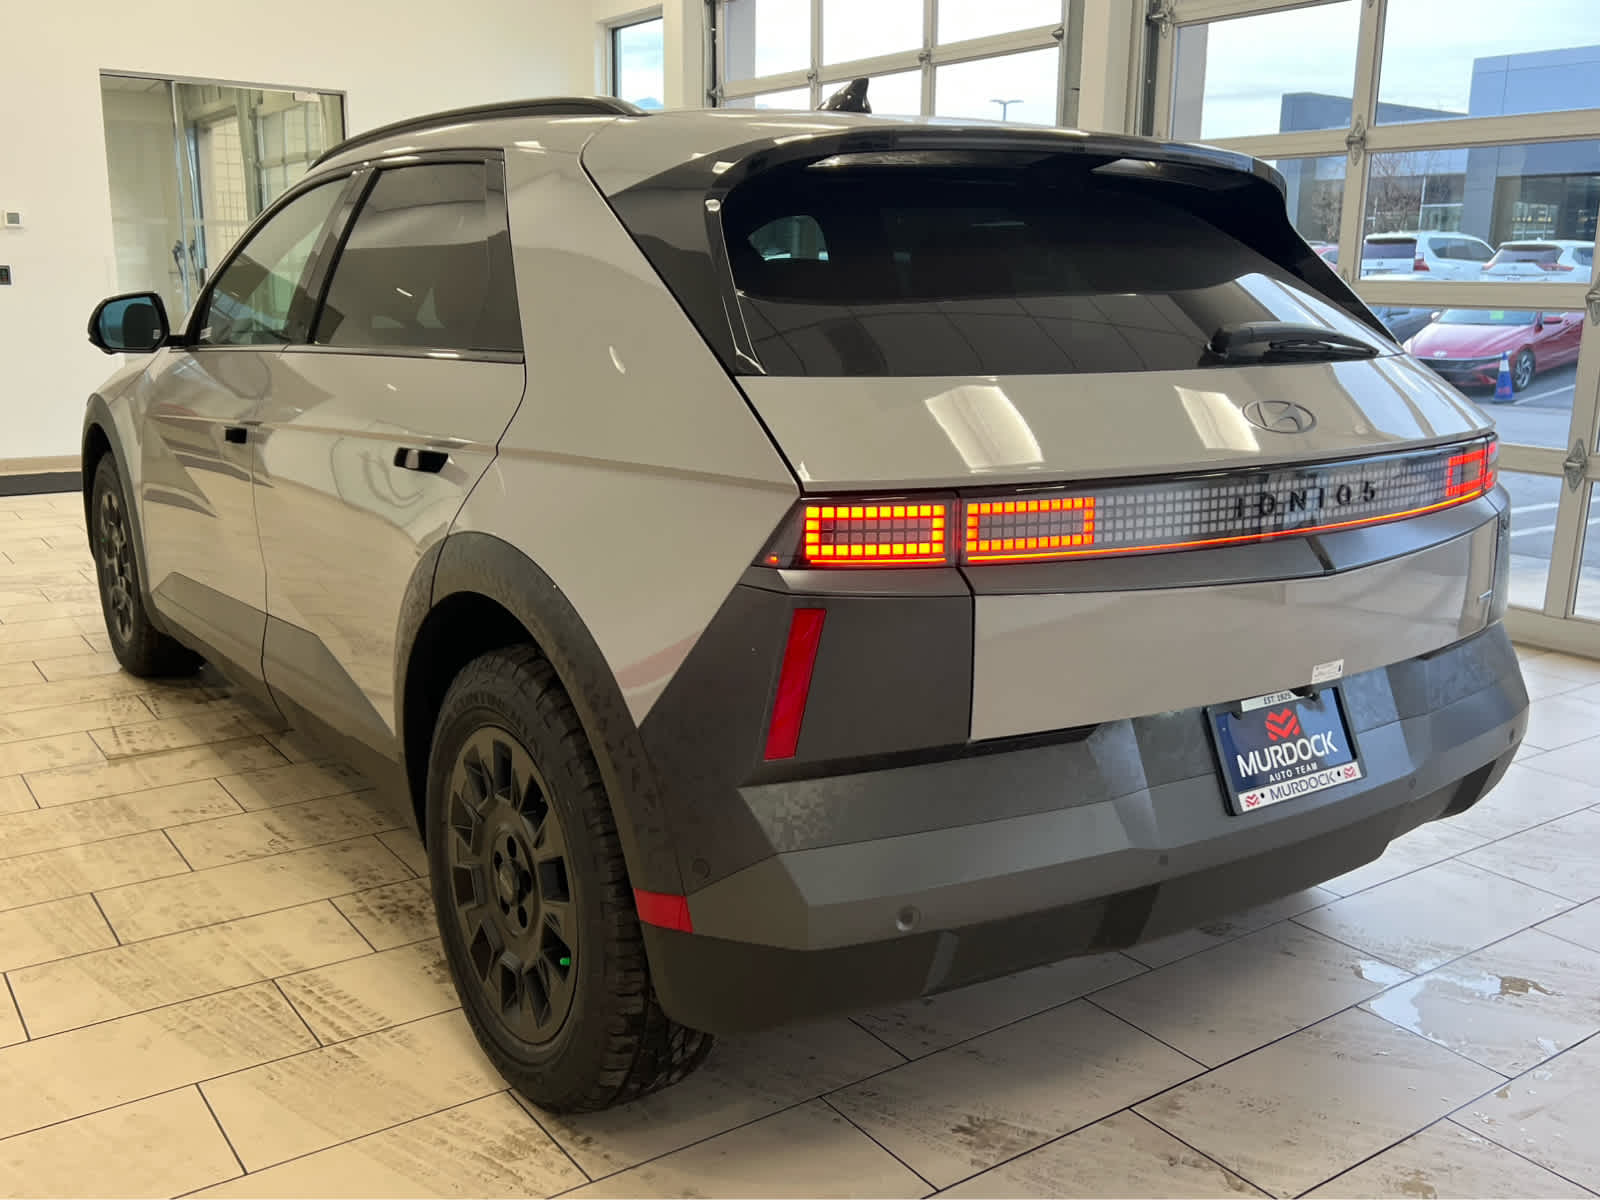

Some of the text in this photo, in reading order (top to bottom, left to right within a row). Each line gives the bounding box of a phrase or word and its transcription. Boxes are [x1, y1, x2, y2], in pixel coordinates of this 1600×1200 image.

[1236, 730, 1338, 778] MURDOCK
[1269, 761, 1318, 783] AUTO TEAM
[1269, 771, 1337, 800] MURDOCK
